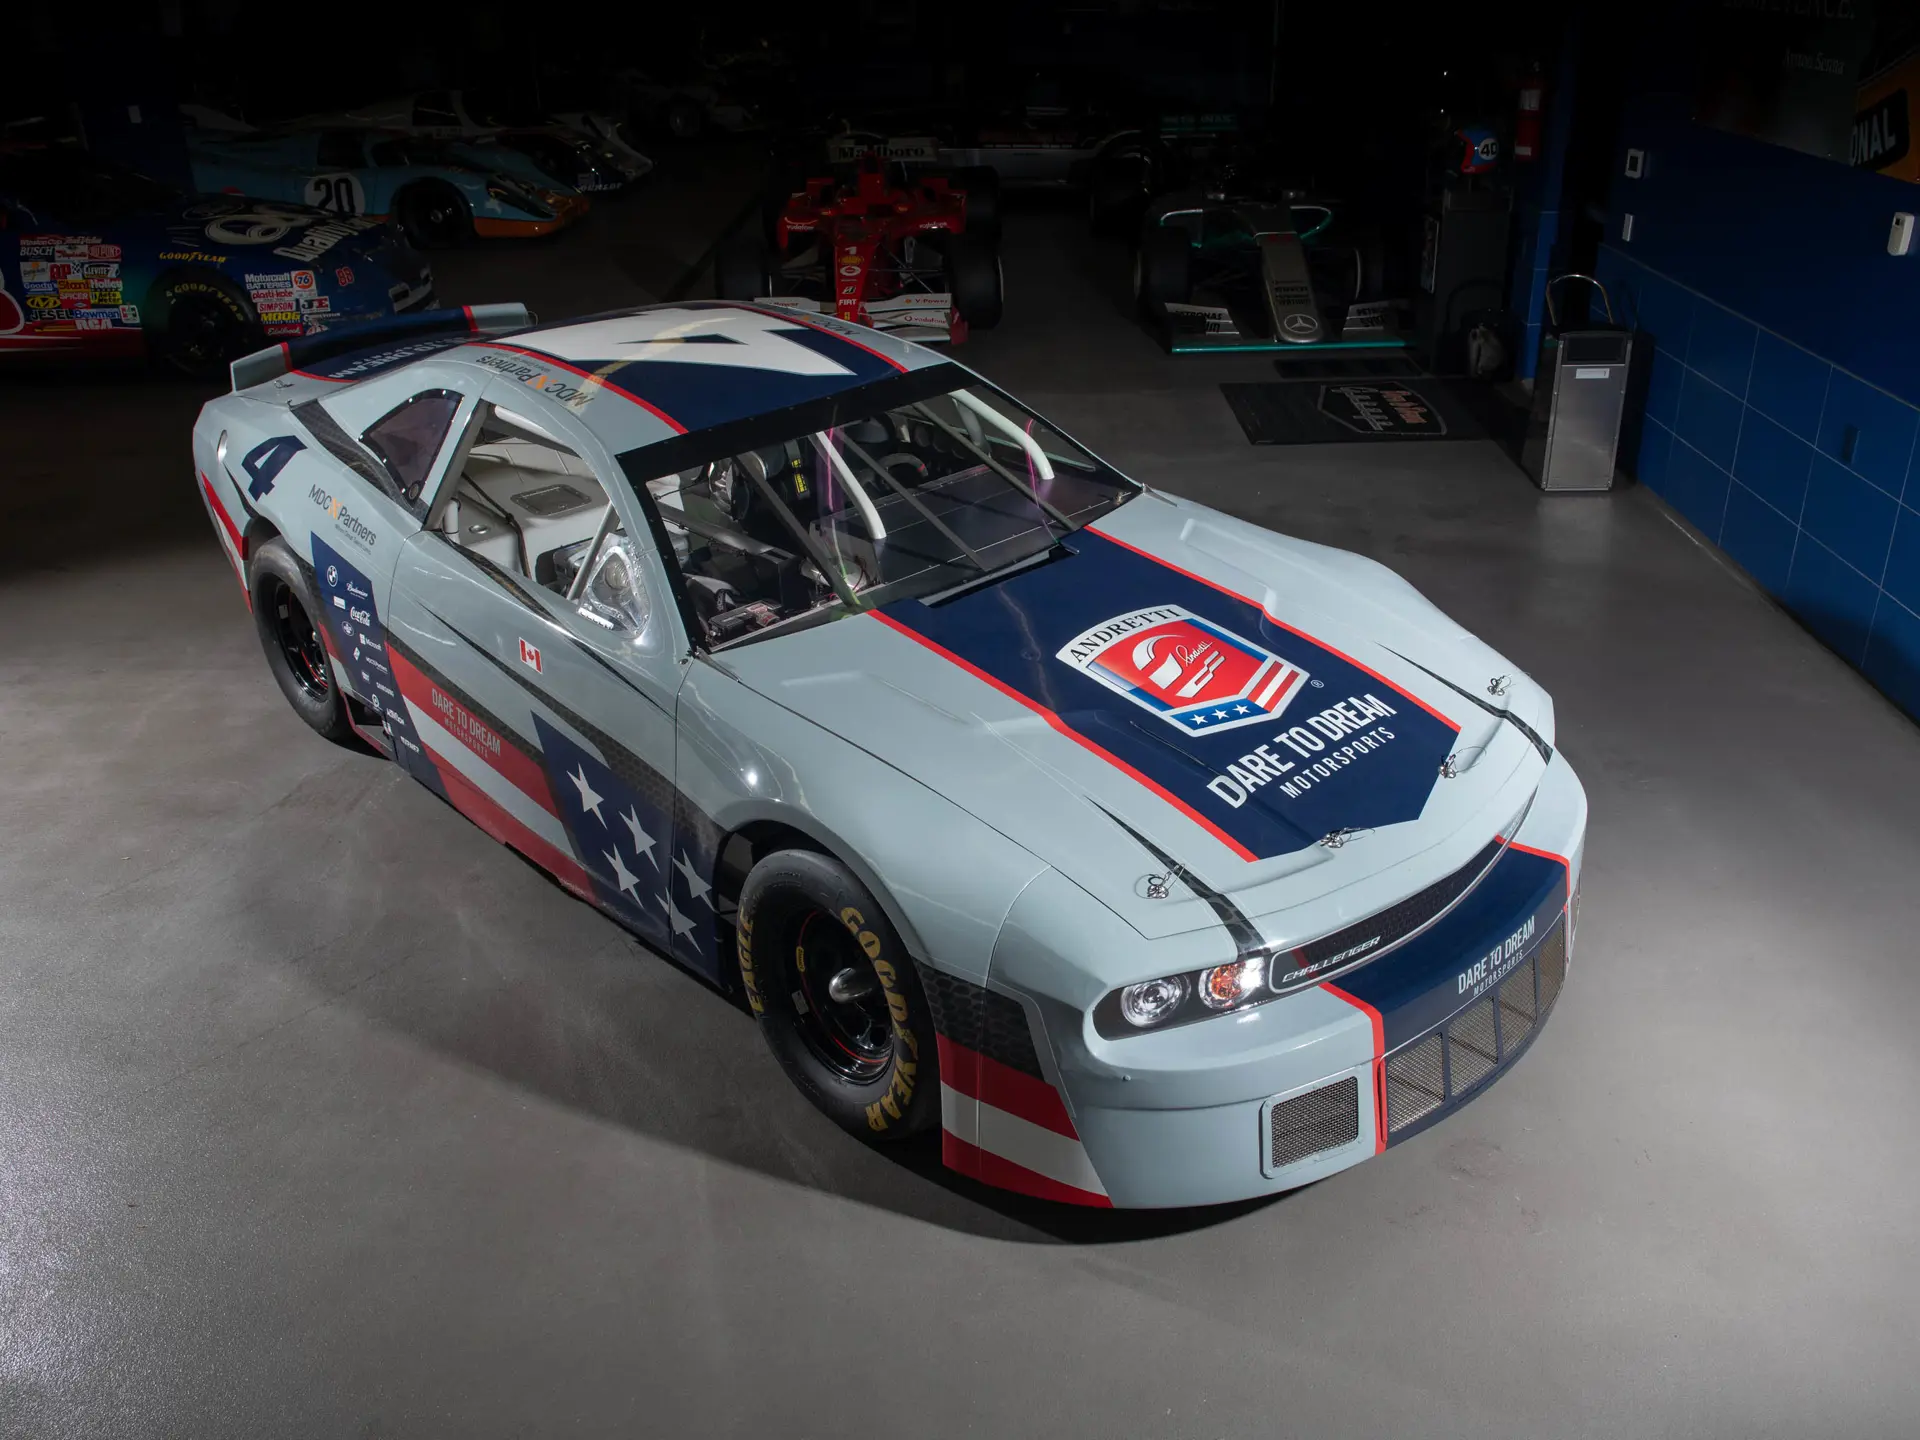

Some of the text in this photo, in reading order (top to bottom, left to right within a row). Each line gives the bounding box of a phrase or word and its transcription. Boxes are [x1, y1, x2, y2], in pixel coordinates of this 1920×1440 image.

[838, 144, 925, 159] Malboro
[312, 177, 356, 215] 20
[20, 246, 54, 256] BUSCH
[158, 251, 228, 263] GOODYEAR
[23, 281, 58, 292] Goody's
[244, 272, 291, 282] Motorcraft
[245, 281, 292, 289] BATTERIES
[296, 274, 311, 285] 76
[31, 309, 74, 320] JESEL
[74, 309, 120, 319] Bowman
[259, 302, 294, 311] SIMPSON
[261, 311, 301, 321] MOOG
[267, 325, 302, 336] Edelbrock
[475, 355, 542, 382] Partners
[545, 382, 595, 407] MDC
[241, 435, 308, 502] 4
[308, 484, 333, 511] MDC
[337, 504, 377, 546] Partners
[1069, 607, 1182, 664] ANDRETTI
[431, 687, 455, 721] DARE
[455, 706, 468, 729] TO
[469, 717, 501, 757] DREAM
[444, 717, 489, 758] MOTORSPORTS
[1206, 692, 1398, 809] DARE TO DREAM
[1279, 725, 1396, 799] MOTORSPORTS
[1281, 935, 1383, 984] CHALLENGER
[1457, 915, 1536, 996] DARE TO DREAM
[1472, 949, 1524, 997] MOTORSPORTS
[839, 906, 919, 1132] GOODYEAR
